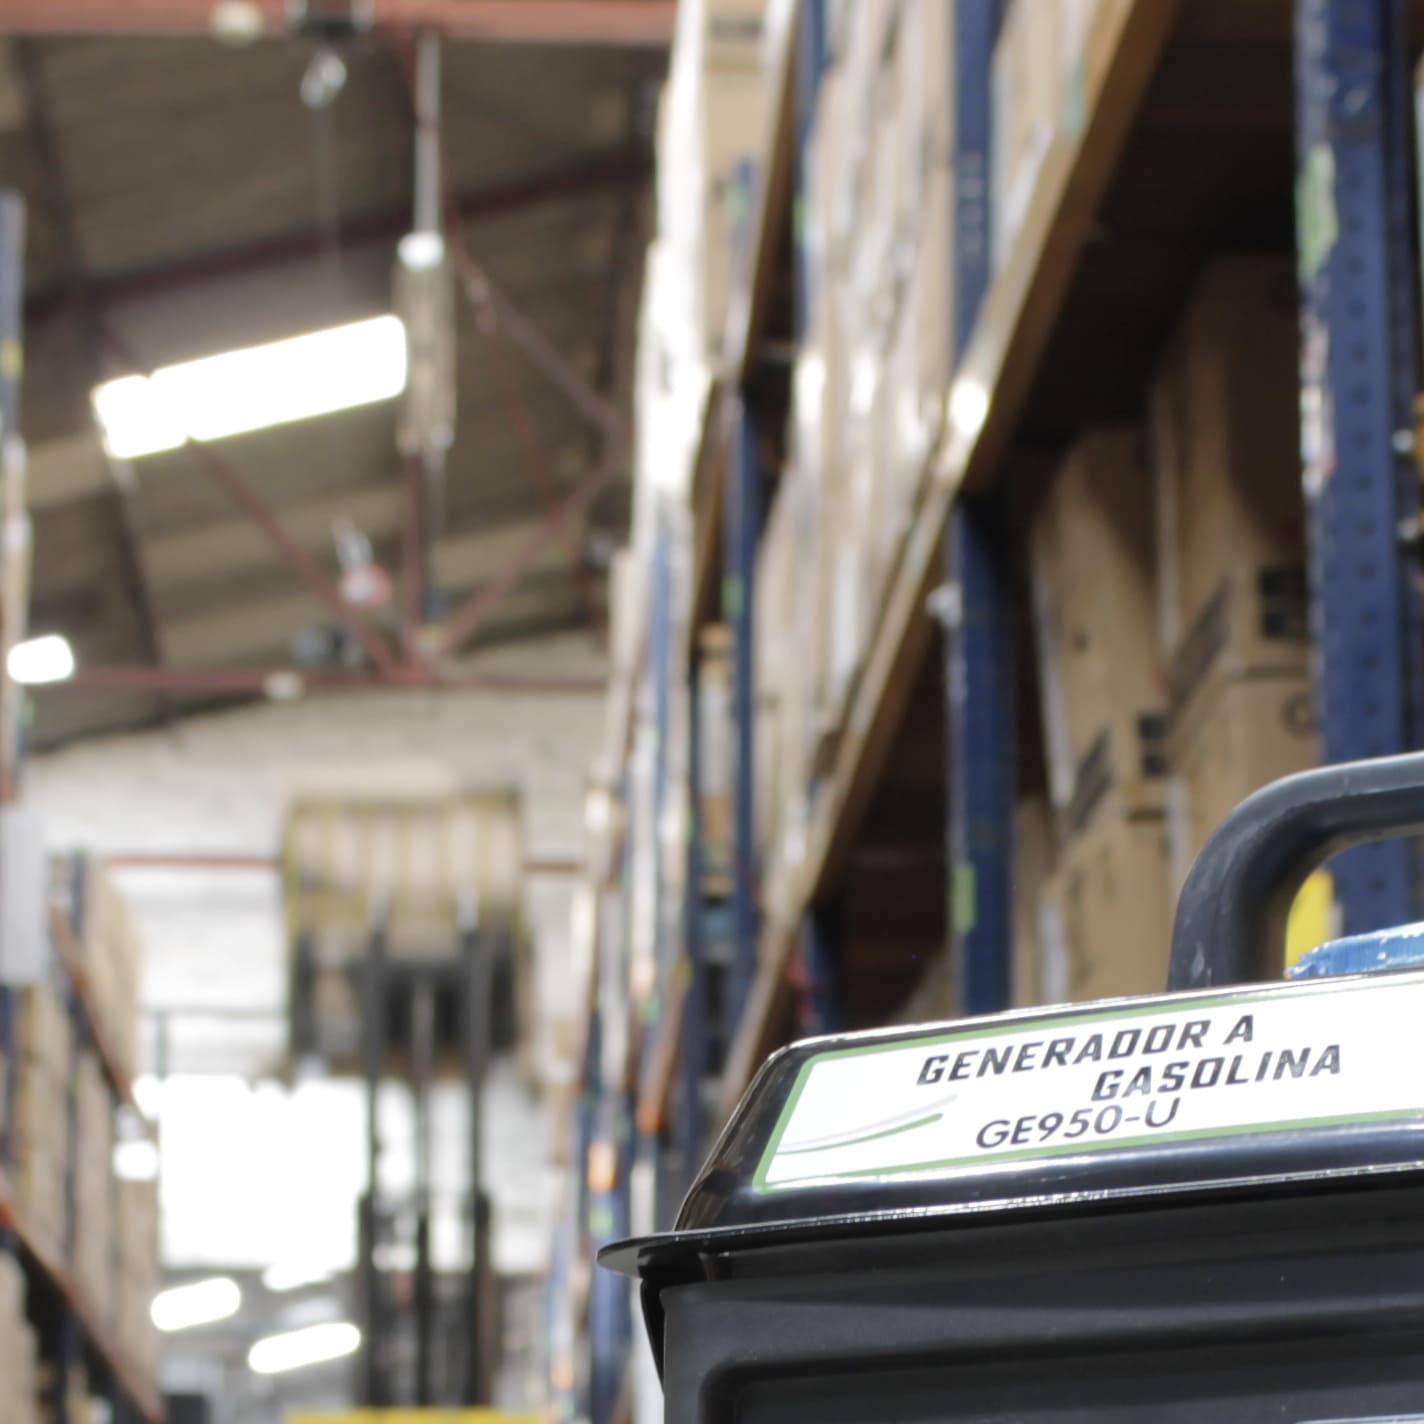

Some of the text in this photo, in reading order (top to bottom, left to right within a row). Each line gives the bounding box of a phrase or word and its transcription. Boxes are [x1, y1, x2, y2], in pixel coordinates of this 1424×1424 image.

[915, 1014, 1254, 1086] GENERADOR A
[1090, 1044, 1342, 1101] GASOLINA
[976, 1097, 1181, 1149] GE950-U
